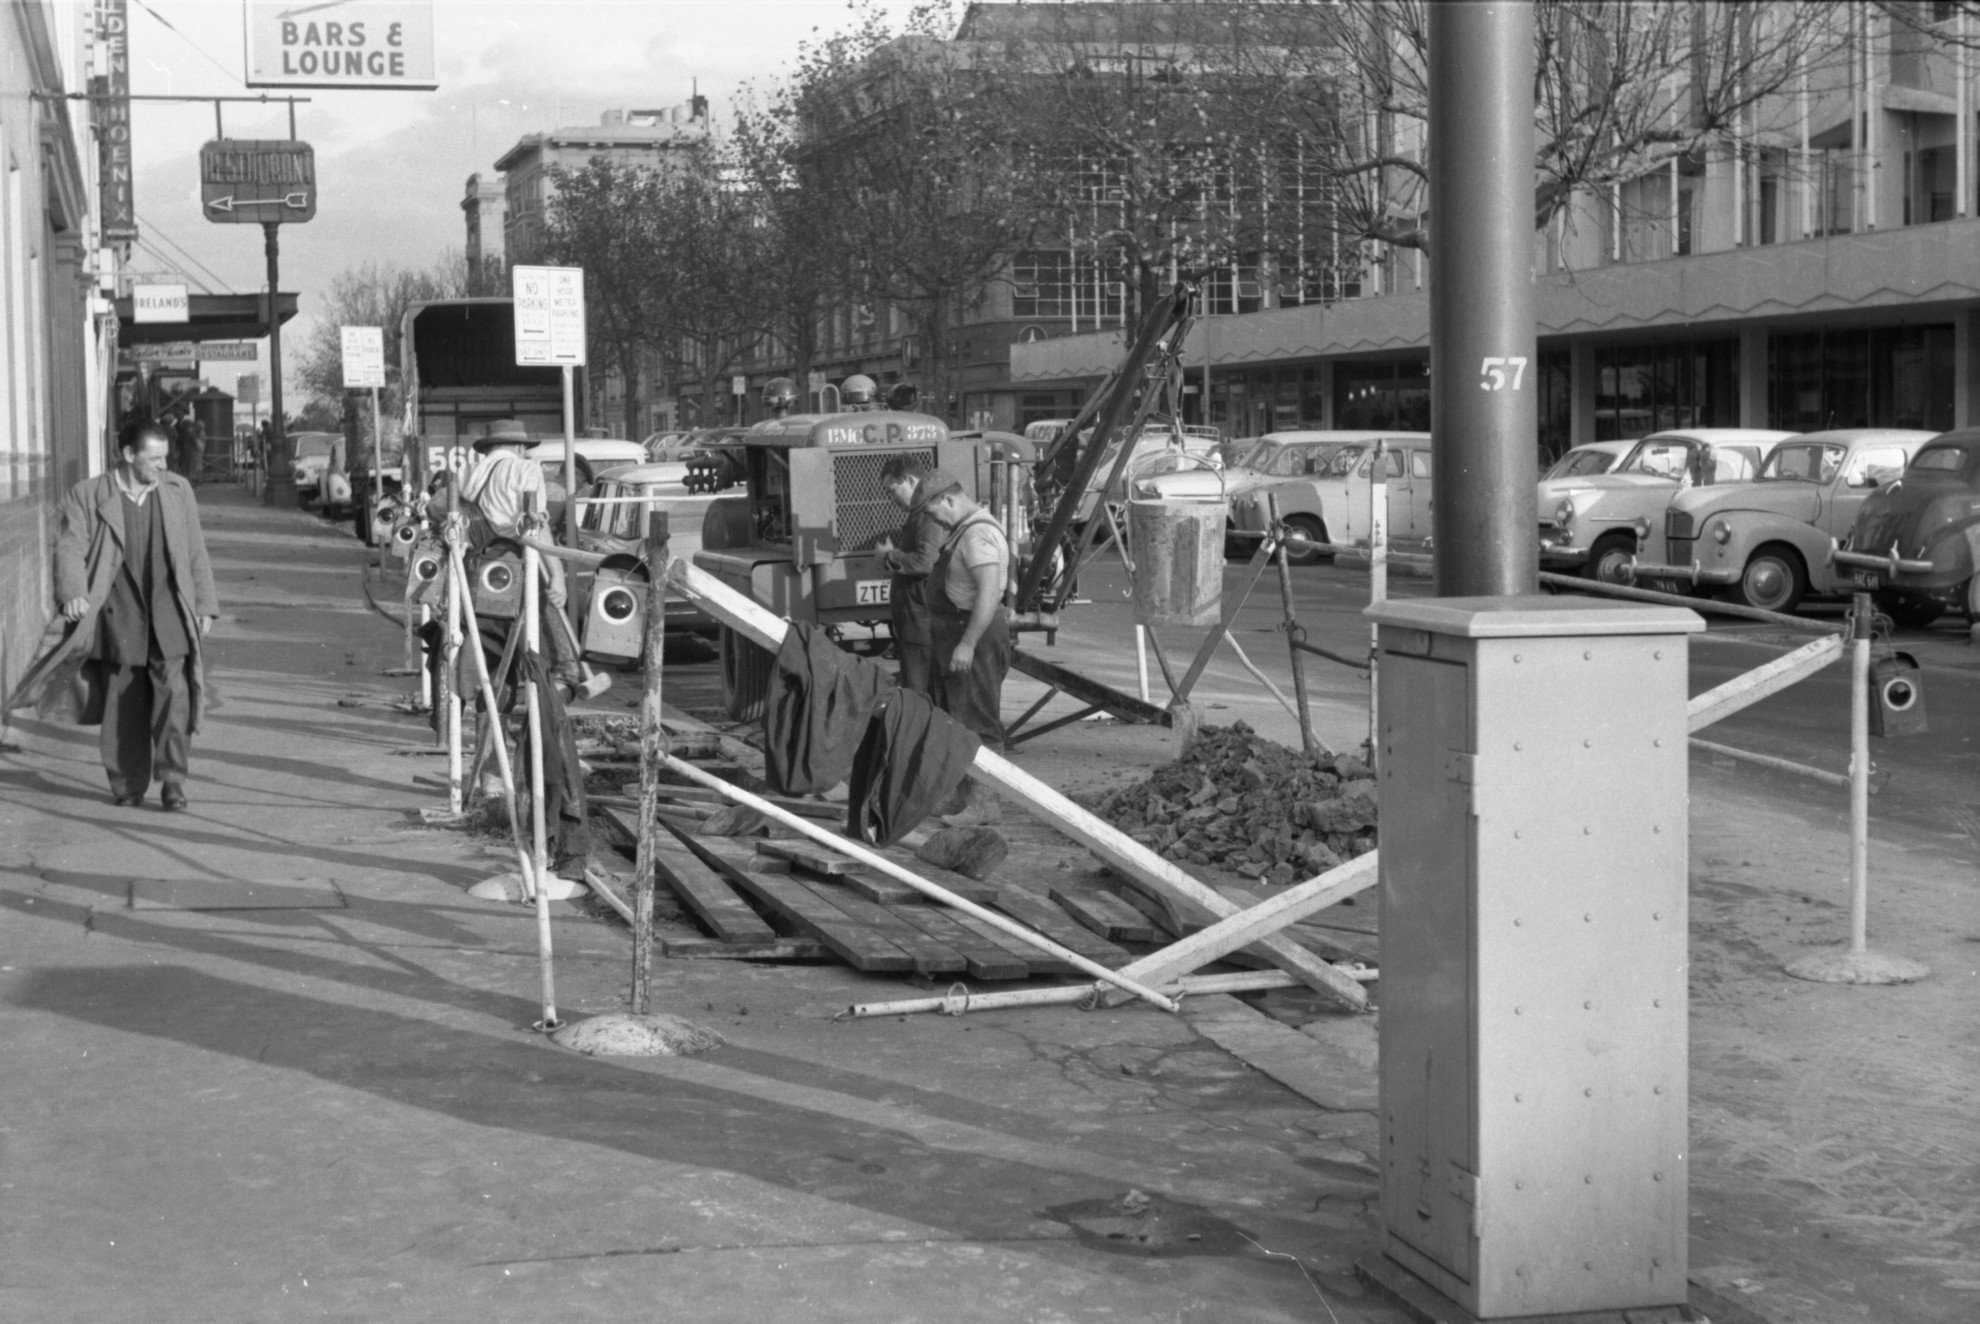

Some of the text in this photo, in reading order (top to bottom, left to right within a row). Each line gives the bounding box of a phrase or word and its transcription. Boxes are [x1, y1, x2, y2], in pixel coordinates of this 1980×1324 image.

[282, 21, 403, 47] BARS &
[283, 50, 405, 76] LOUNGE
[203, 151, 313, 185] RESTAURANT
[559, 275, 571, 285] ONE
[526, 281, 539, 296] NO
[557, 287, 574, 295] HOUR
[135, 297, 187, 309] IRELANDS
[518, 296, 549, 311] PARKING
[553, 298, 577, 307] METER
[551, 308, 580, 318] PARKING
[1480, 356, 1528, 391] 57
[860, 585, 889, 602] ZTE
